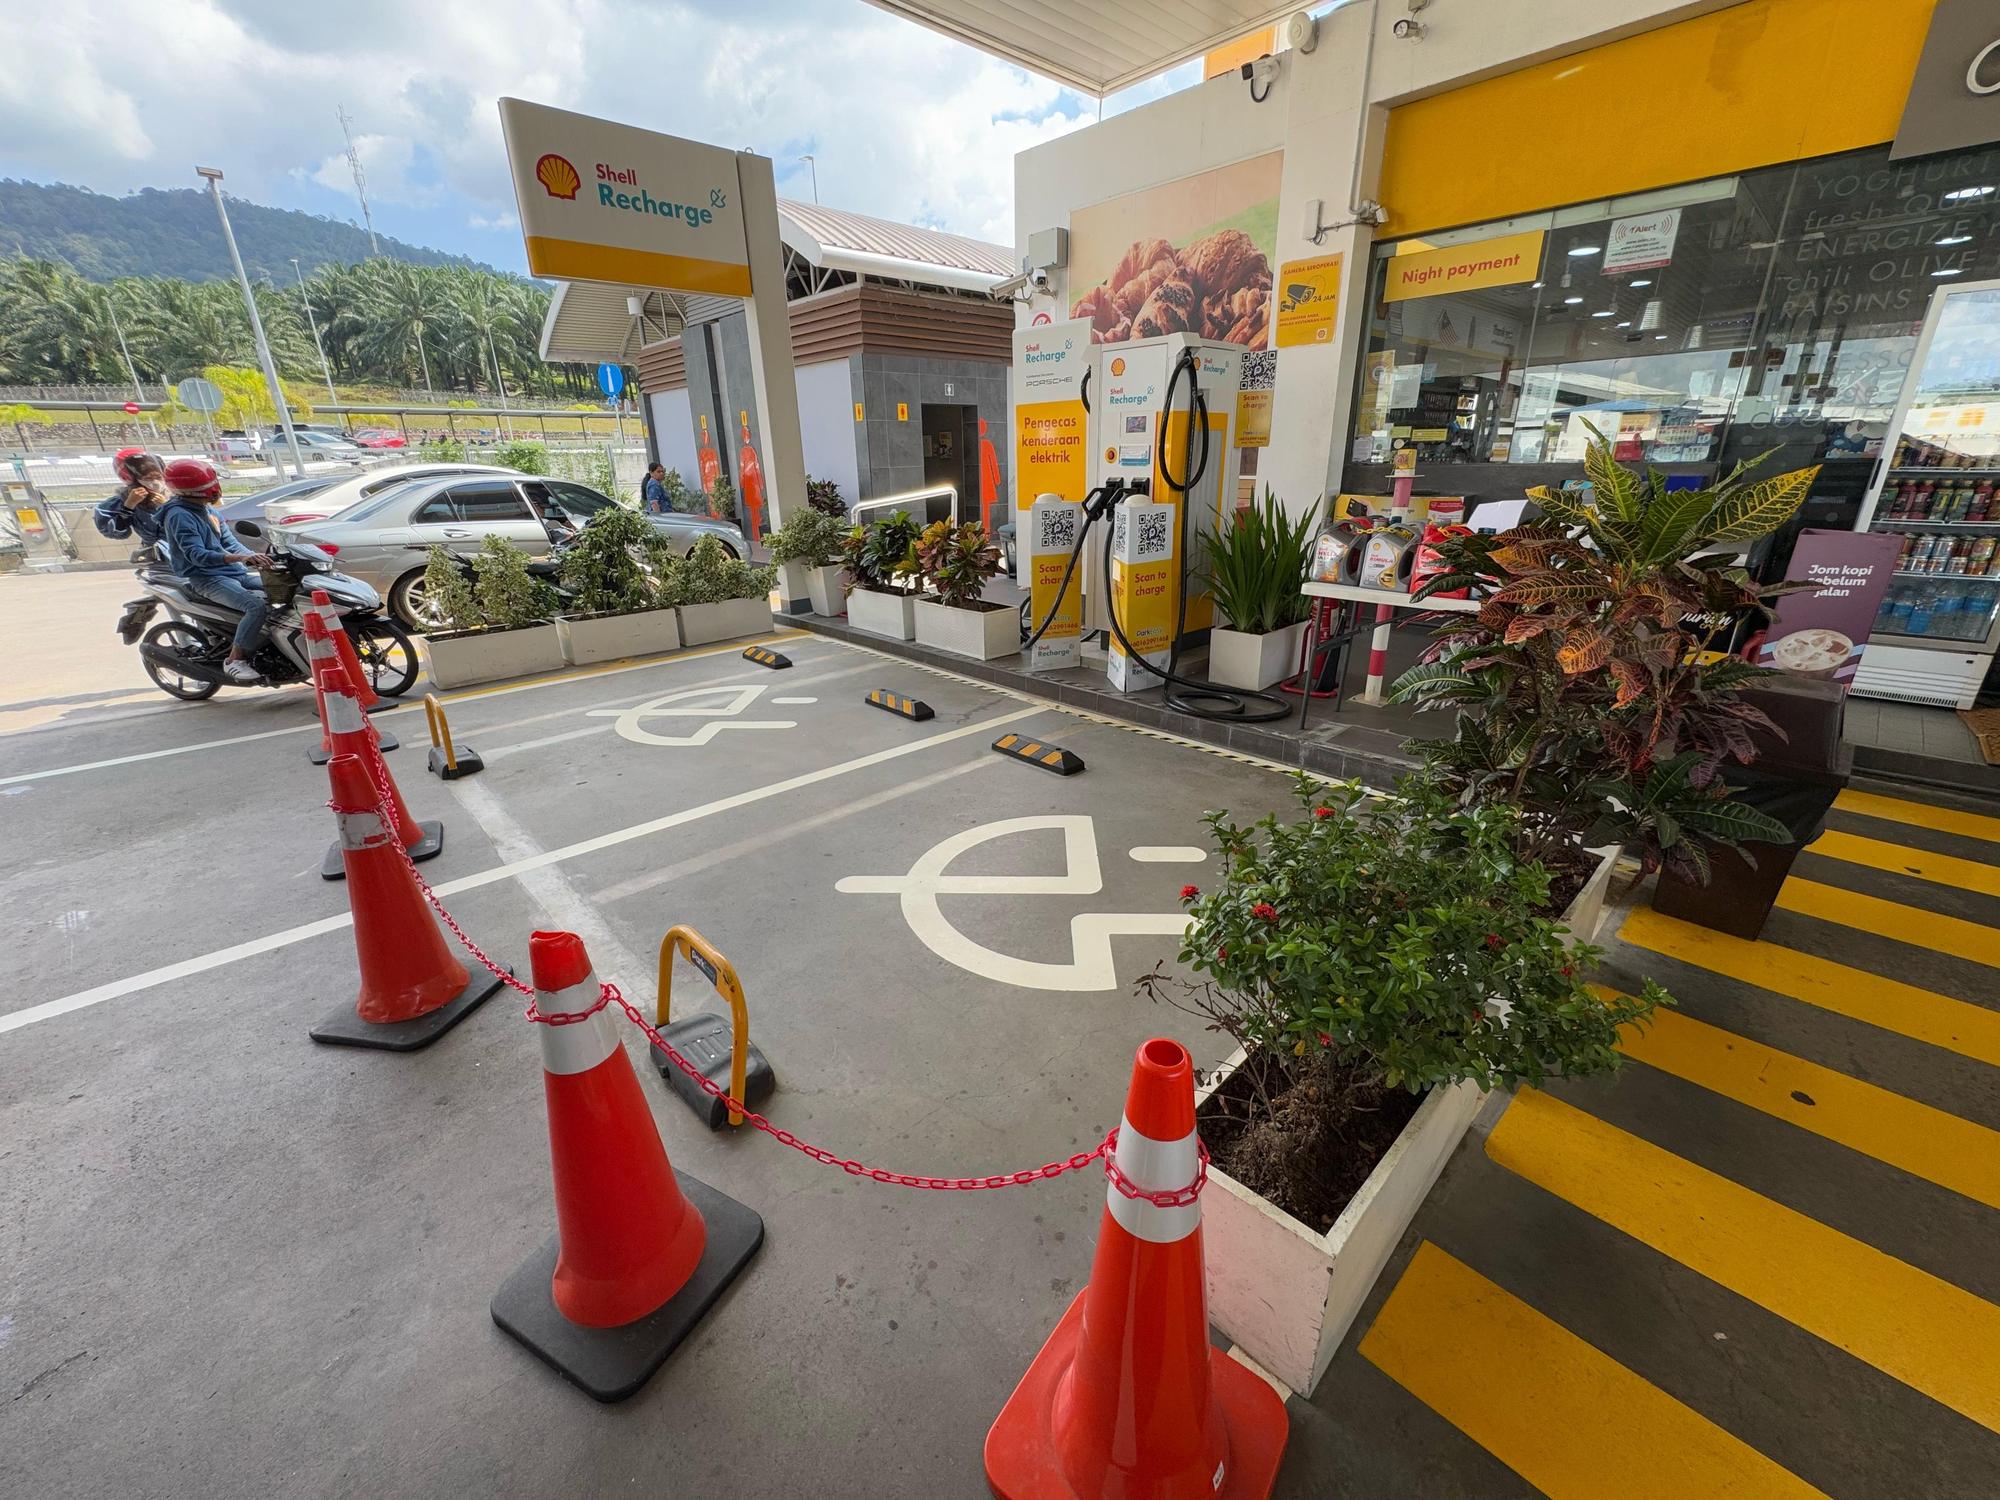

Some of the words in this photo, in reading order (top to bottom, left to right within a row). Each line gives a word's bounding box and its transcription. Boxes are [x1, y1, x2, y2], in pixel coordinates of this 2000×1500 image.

[596, 164, 637, 186] Shell
[597, 183, 713, 228] Recharge
[1804, 202, 1882, 231] fresh
[1796, 219, 1971, 262] ENERGIZE
[1402, 266, 1443, 284] Night
[1447, 254, 1520, 280] payment
[1787, 265, 1852, 292] chili
[1869, 250, 1978, 281] OLIVE
[1779, 288, 1912, 320] RAISINS
[1025, 344, 1040, 352] Shell
[1025, 351, 1066, 364] Recharge
[1026, 376, 1073, 387] PORSCHE
[1109, 394, 1148, 405] Recharge
[1024, 417, 1076, 431] Pengecas
[1022, 434, 1080, 447] kenderaan
[1030, 450, 1071, 463] elektrik
[1039, 564, 1062, 573] Scan
[1808, 564, 1840, 575] Jom
[1841, 565, 1875, 577] kopi
[1040, 576, 1073, 585] chare
[1135, 573, 1156, 583] Scan
[1158, 572, 1167, 580] to
[1135, 585, 1165, 596] charge
[1038, 649, 1070, 657] Recharge
